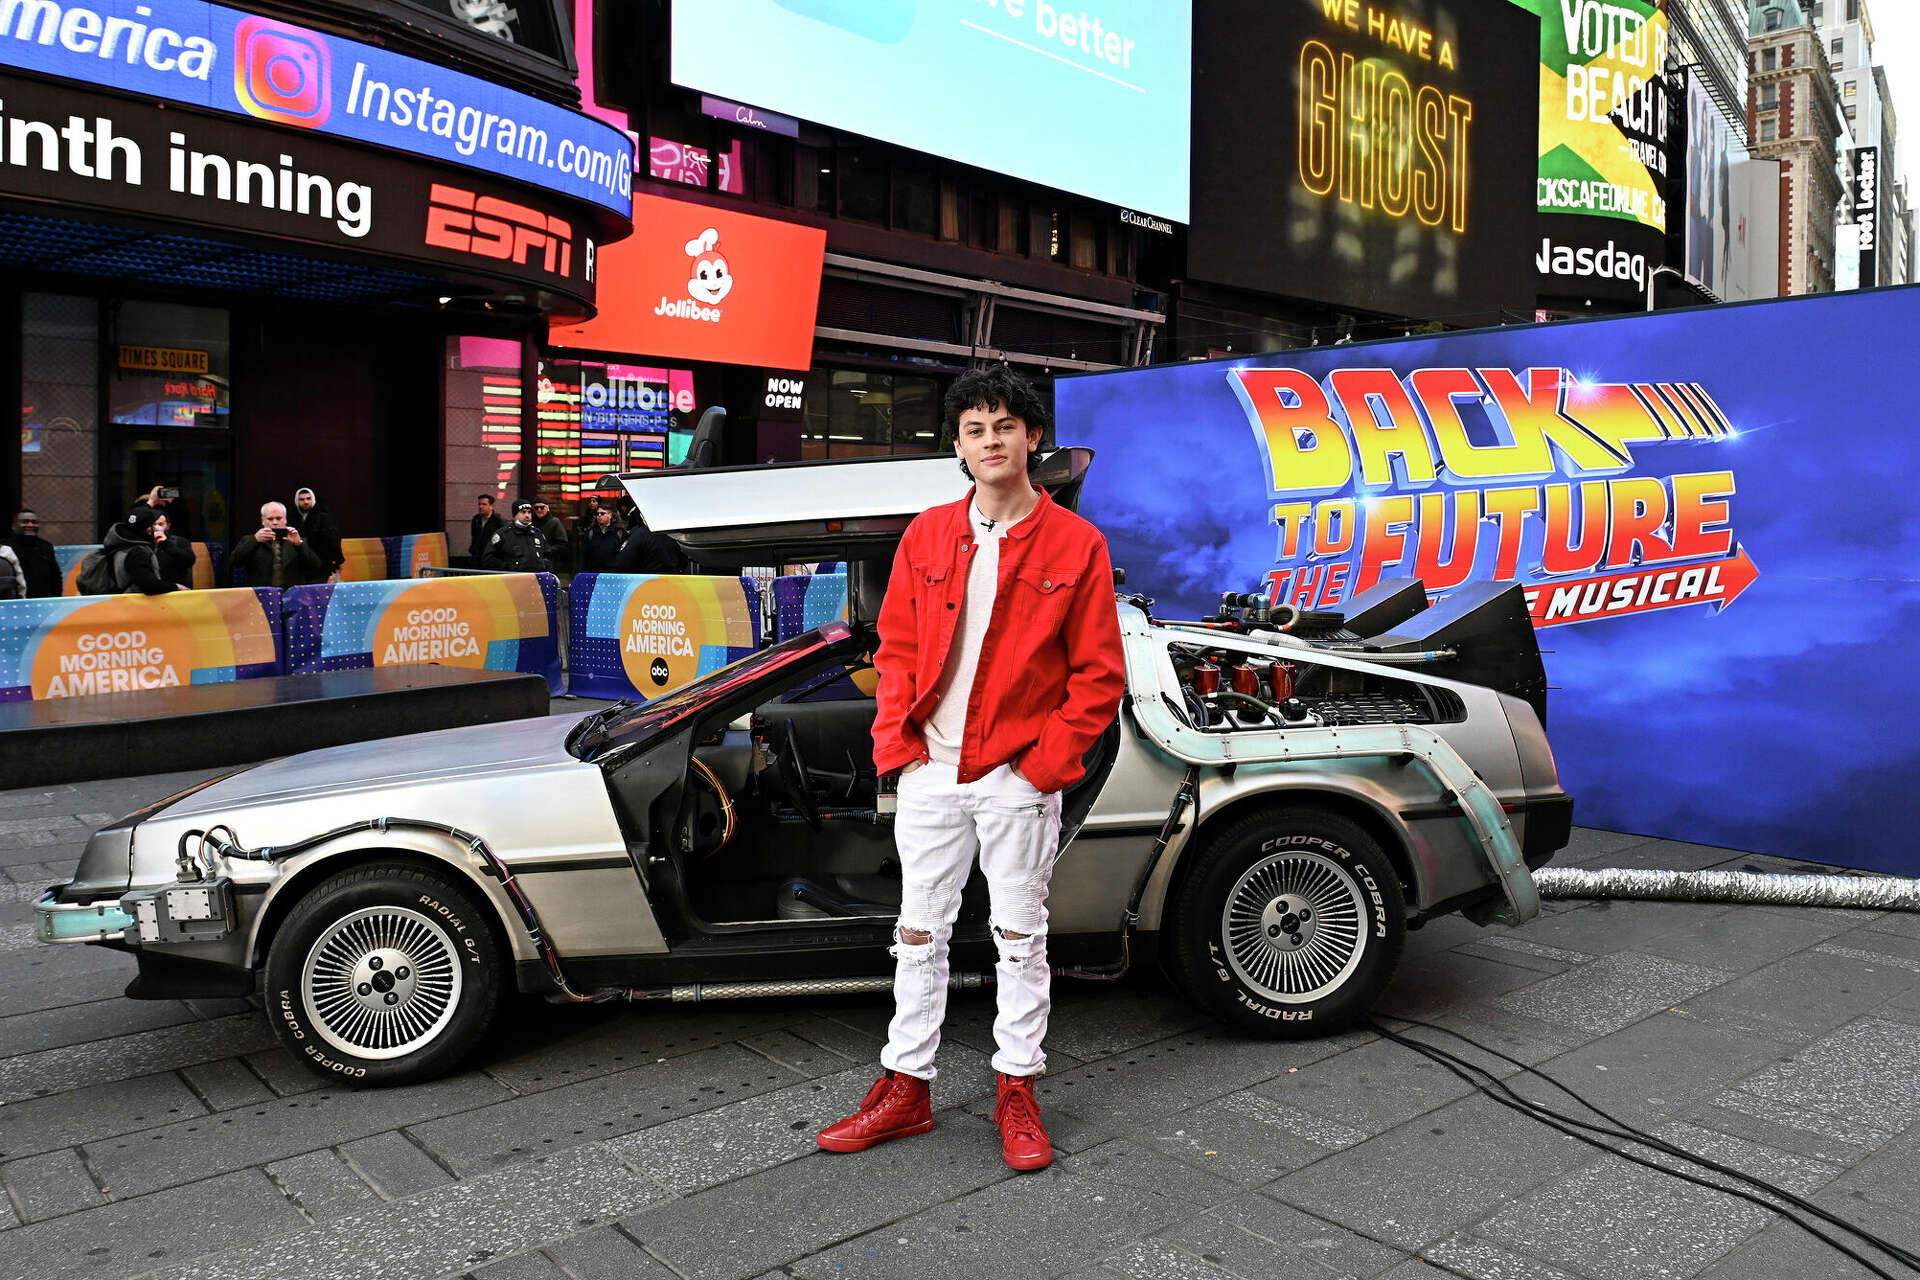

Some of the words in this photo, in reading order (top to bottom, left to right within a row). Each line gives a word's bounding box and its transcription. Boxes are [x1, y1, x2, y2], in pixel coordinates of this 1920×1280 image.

[1036, 0, 1135, 68] better
[1322, 0, 1360, 31] WE
[1367, 8, 1433, 61] HAVE
[1438, 41, 1456, 70] A
[1560, 0, 1648, 68] VOTED
[736, 106, 767, 128] Calm
[1566, 64, 1653, 136] BEACH
[1299, 40, 1472, 232] GHOST
[169, 131, 371, 238] inning
[425, 183, 573, 278] ESPN
[654, 296, 721, 323] Jollibee
[121, 347, 158, 367] TIMES
[160, 350, 206, 371] SQUARE
[765, 394, 802, 409] OPEN
[768, 378, 804, 395] NOW
[1228, 366, 1736, 498] BACK
[1271, 498, 1356, 561] TO
[1350, 470, 1737, 600] FUTURE
[1264, 563, 1351, 612] THE
[1544, 566, 1727, 621] MUSICAL
[407, 608, 457, 625] GOOD
[632, 619, 686, 636] MORNING
[641, 604, 677, 619] GOOD
[77, 631, 147, 652] GOOD
[393, 622, 470, 642] MORNING
[625, 634, 695, 657] AMERICA
[60, 647, 165, 673] MORNING
[382, 637, 480, 665] AMERICA
[46, 665, 181, 699] AMERICA
[651, 665, 668, 679] abc
[1261, 835, 1351, 860] COOPER
[1354, 863, 1387, 938] COBRA
[419, 894, 466, 935] RADIAL
[464, 937, 481, 964] G/T
[279, 989, 305, 1040] COBRA
[1237, 988, 1313, 1021] RADIAL
[304, 1044, 367, 1079] COOPER
